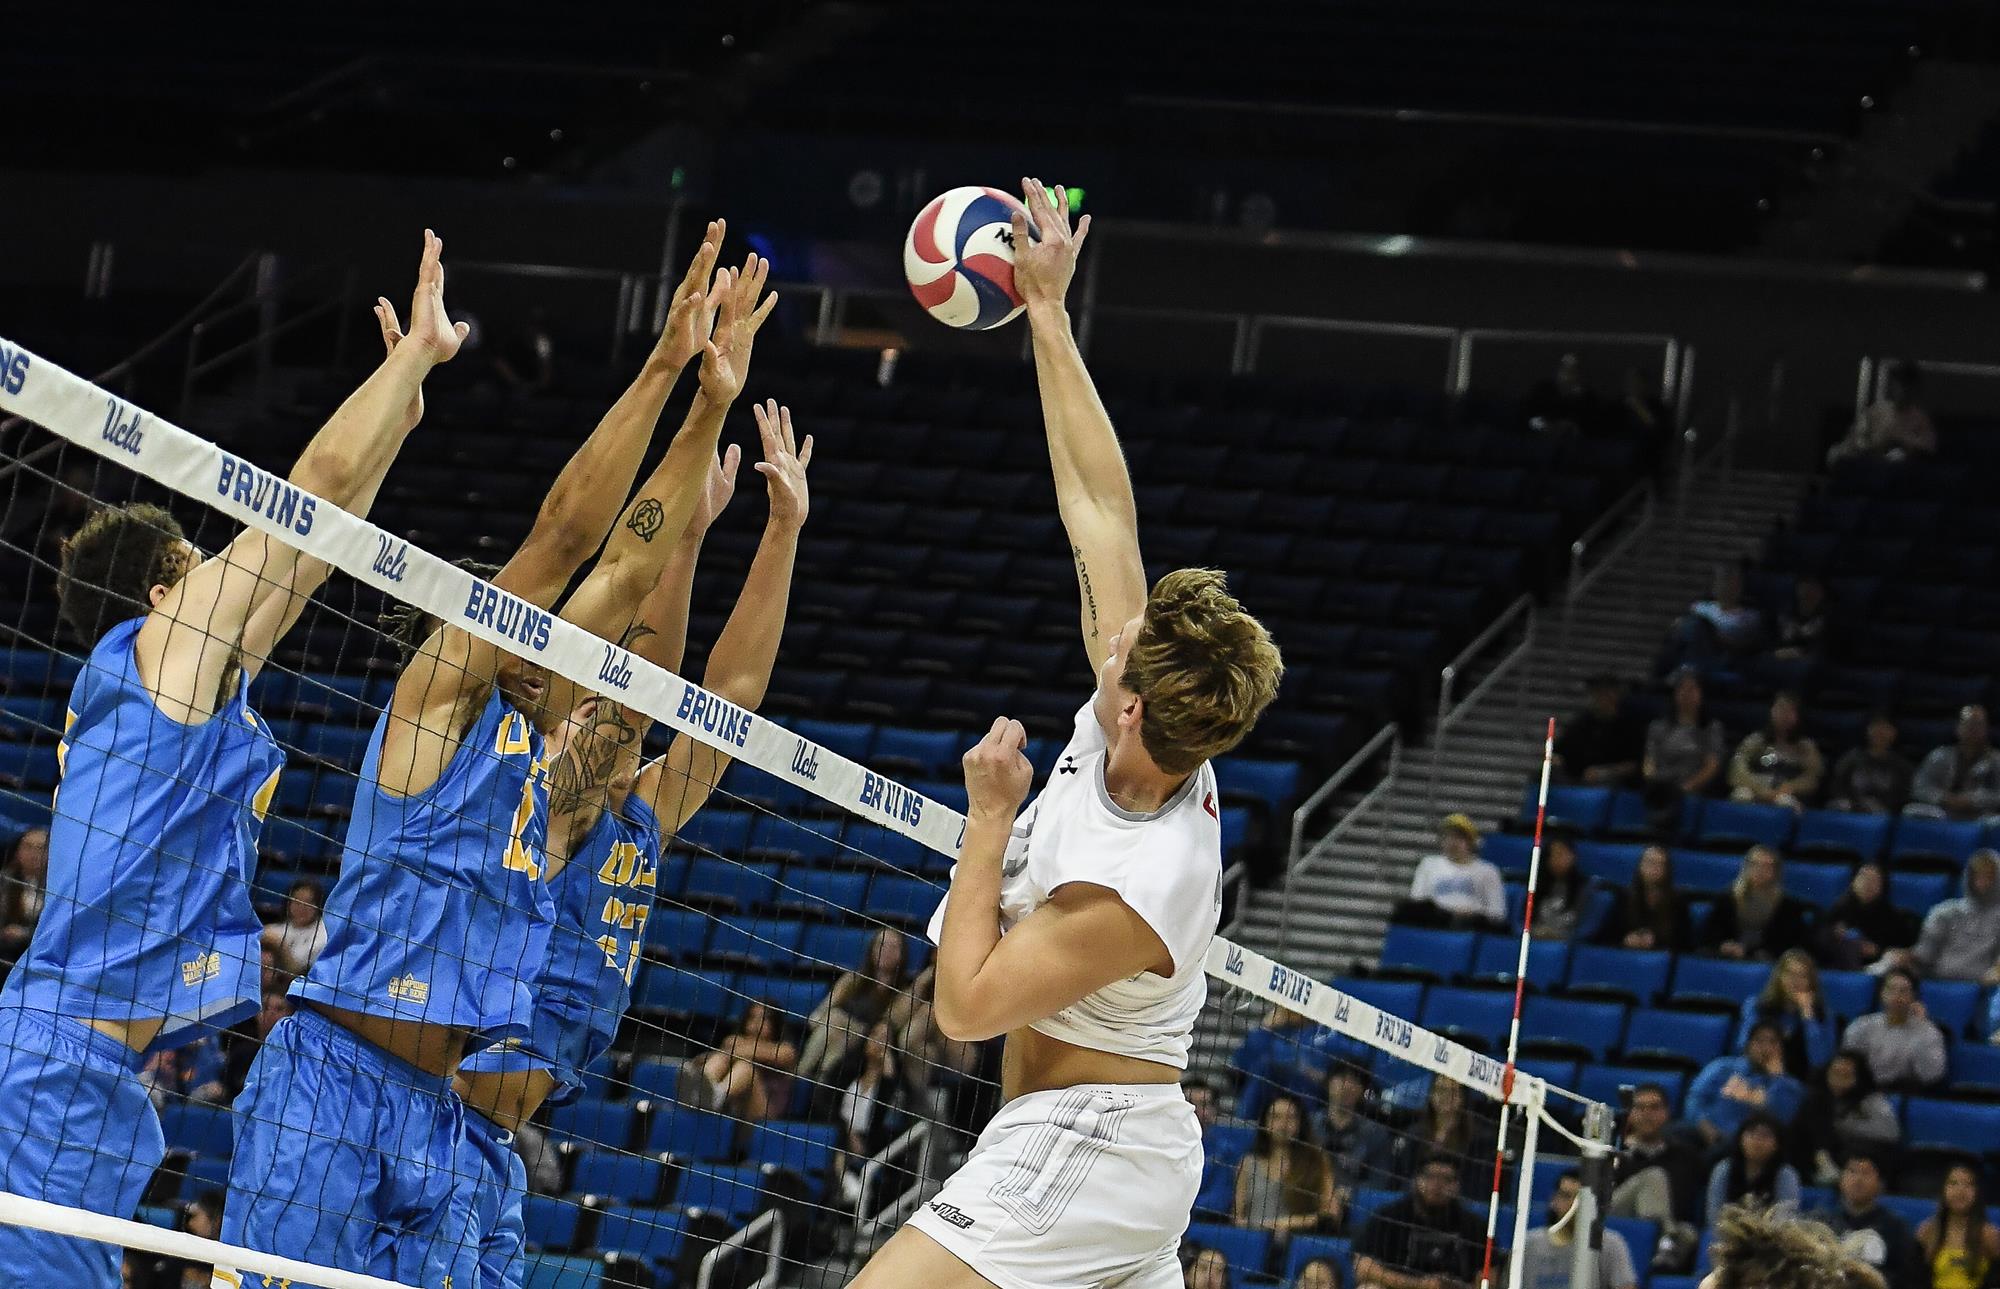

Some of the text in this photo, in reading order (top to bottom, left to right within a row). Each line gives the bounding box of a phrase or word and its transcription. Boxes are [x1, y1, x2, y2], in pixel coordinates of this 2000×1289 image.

[217, 455, 317, 537] BRUINS
[464, 579, 553, 651] BRUINS
[676, 683, 752, 748] BRUINS
[859, 771, 923, 828] BRUINS
[1268, 965, 1313, 1006] BRUINS
